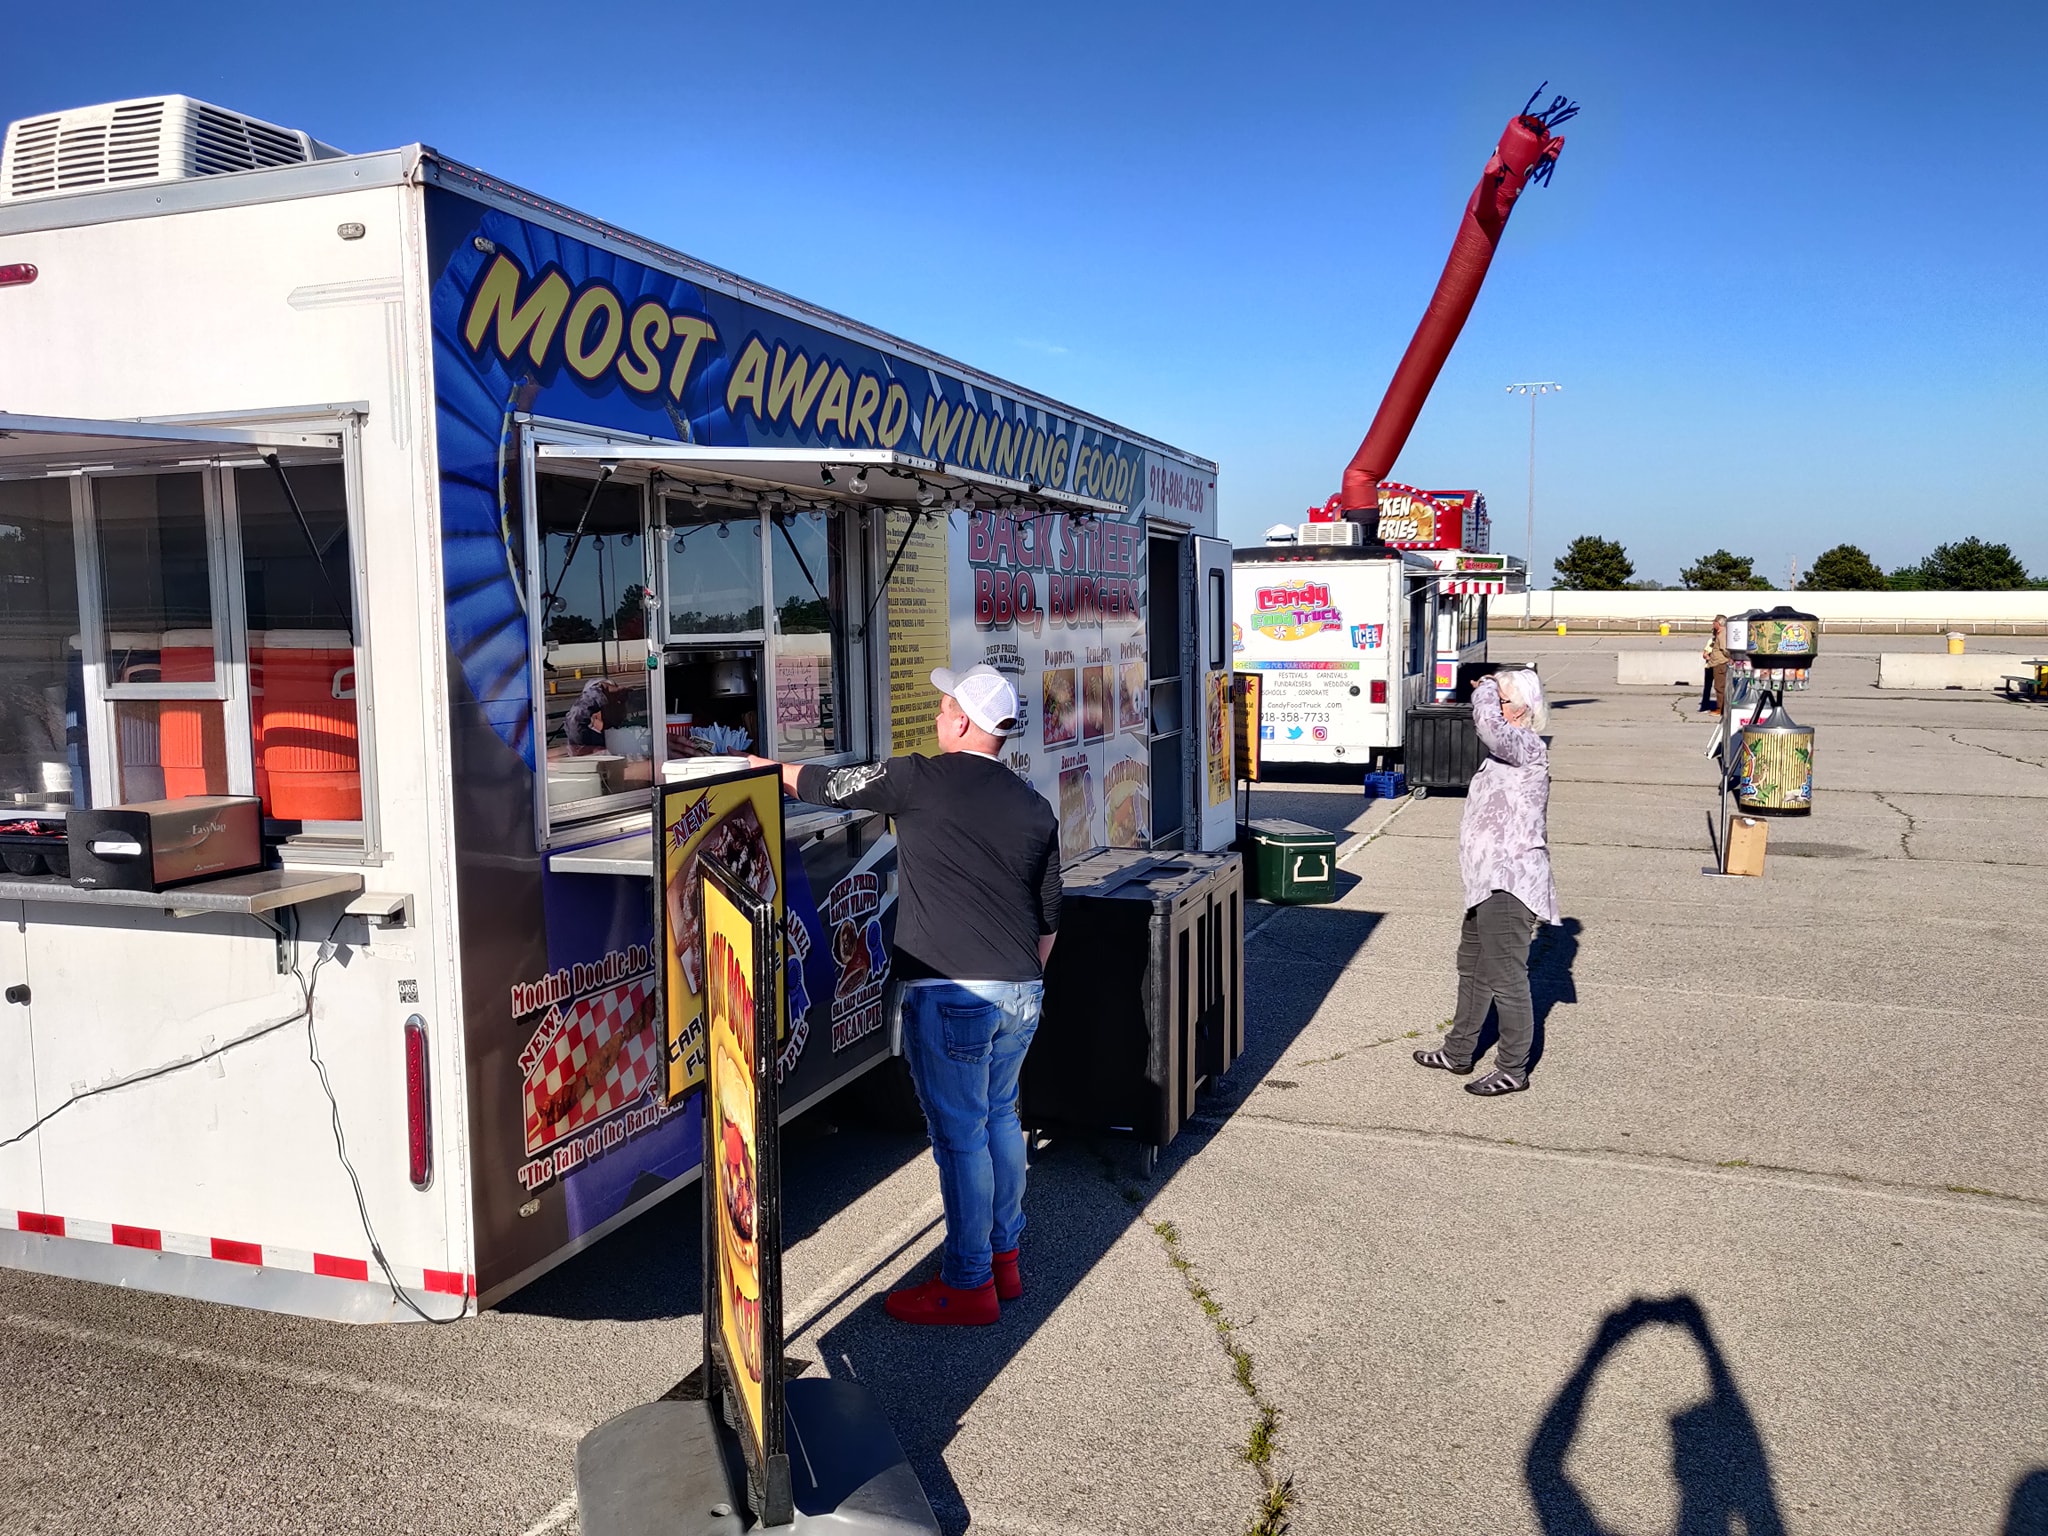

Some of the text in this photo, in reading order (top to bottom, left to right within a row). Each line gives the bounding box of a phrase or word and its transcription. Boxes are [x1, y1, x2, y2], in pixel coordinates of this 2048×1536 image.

[465, 253, 1139, 502] MOST AWARD WINNING FOOD!
[1150, 464, 1204, 514] 918-808-4236
[969, 510, 1141, 575] BACK STREET
[1378, 519, 1419, 541] FRIES
[975, 568, 1043, 633] BBQ,
[1050, 573, 1140, 624] BURGERS
[1257, 583, 1328, 610] Candy
[986, 643, 1017, 656] DEEP FRIED
[1354, 628, 1378, 645] ICEE
[999, 654, 1025, 667] WRAPPED
[1274, 680, 1312, 688] FUNDRAISERS
[1298, 689, 1329, 697] CORPORATE
[673, 798, 710, 848] NEW
[519, 1007, 562, 1075] NEW!
[586, 1133, 602, 1157] of
[603, 1118, 625, 1149] the
